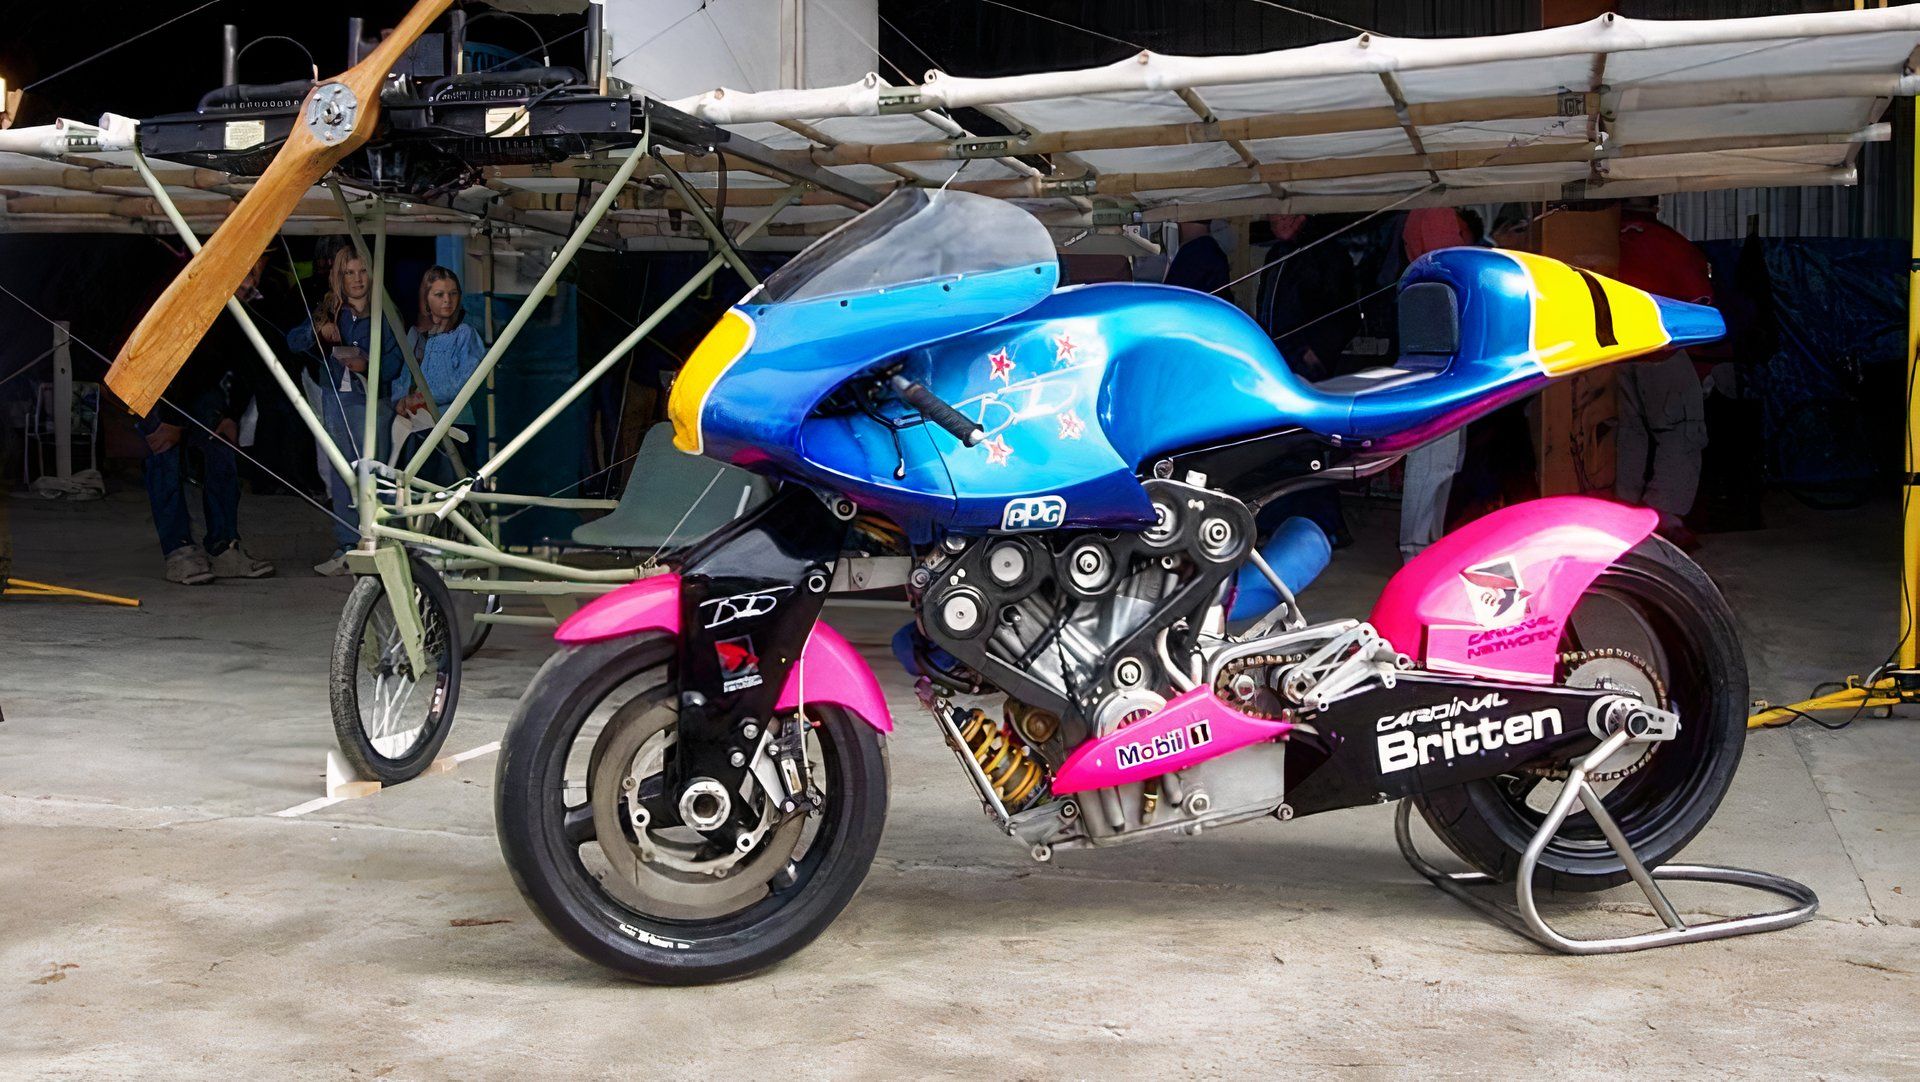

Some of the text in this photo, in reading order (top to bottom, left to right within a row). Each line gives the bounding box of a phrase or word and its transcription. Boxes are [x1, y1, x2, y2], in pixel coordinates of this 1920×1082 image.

[1005, 499, 1062, 528] PPG
[1117, 722, 1210, 768] Mobil 1
[1377, 708, 1563, 774] Britten
